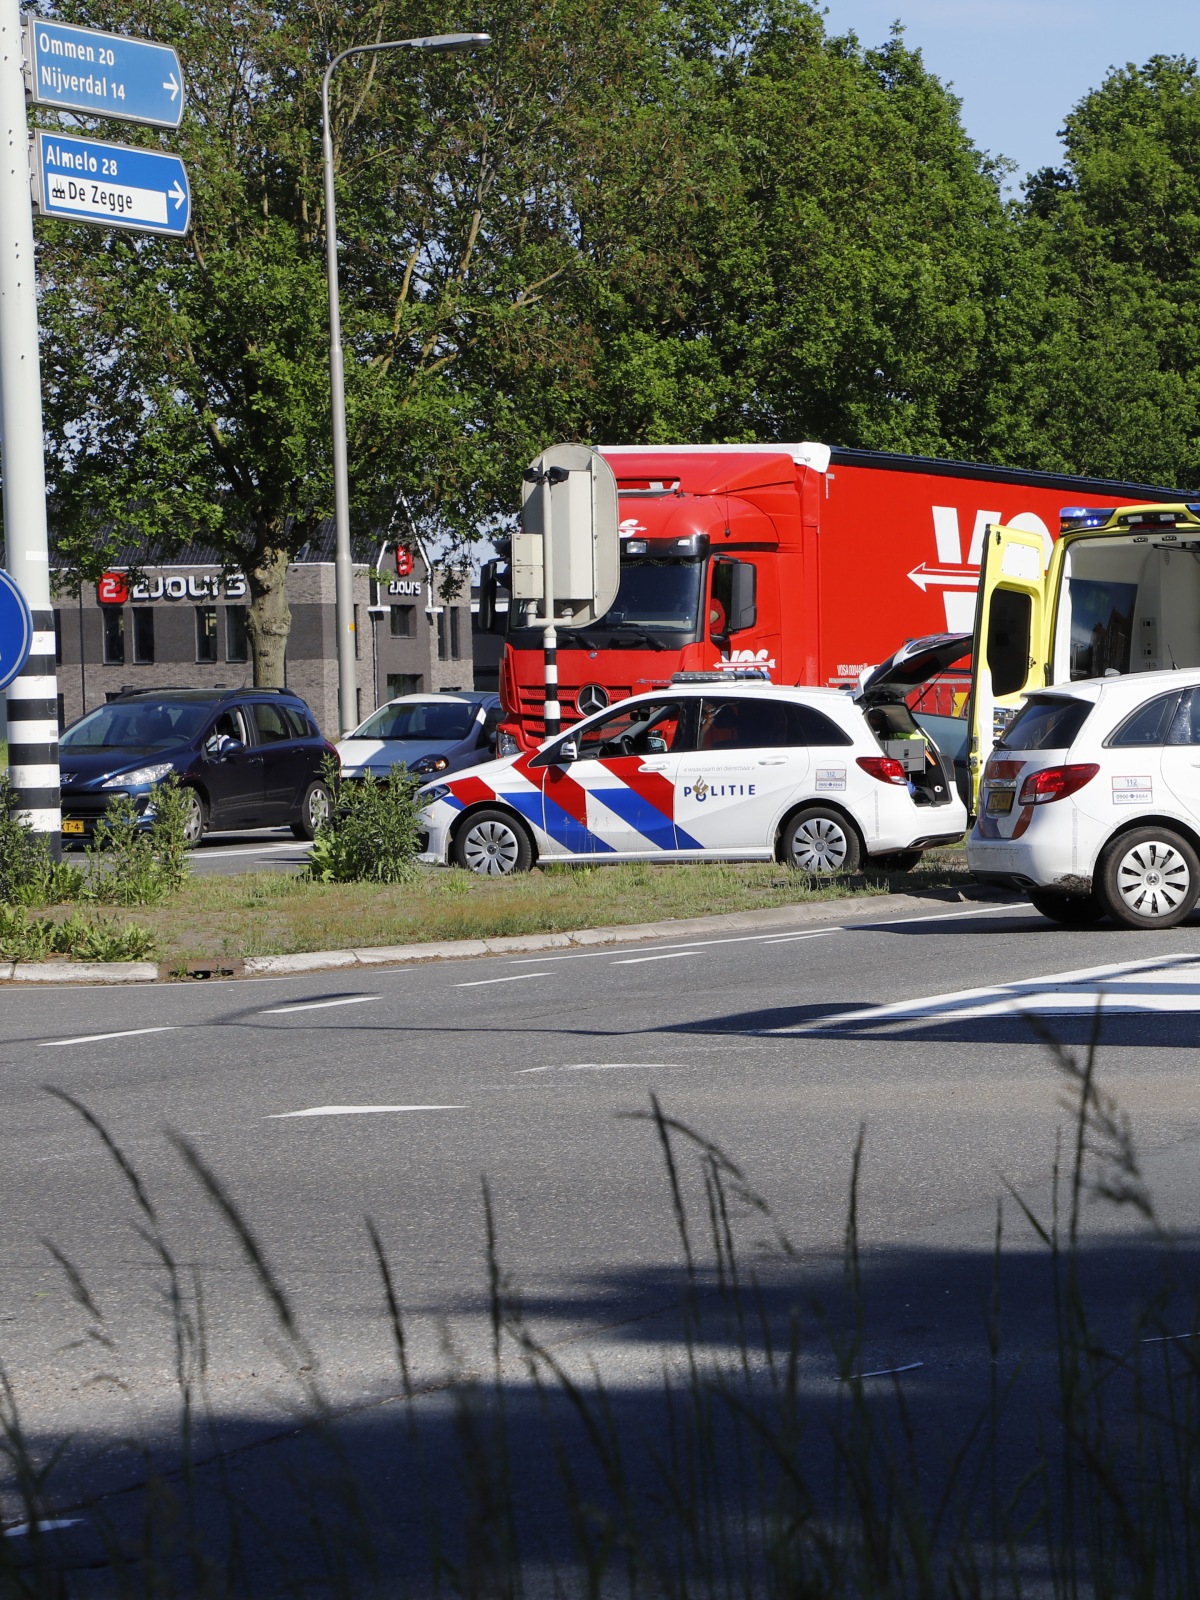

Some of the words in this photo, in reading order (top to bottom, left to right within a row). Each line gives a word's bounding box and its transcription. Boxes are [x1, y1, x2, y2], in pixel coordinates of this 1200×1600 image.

[39, 32, 95, 62] Ommen
[98, 48, 115, 66] 20
[41, 66, 107, 98] Nijverdal
[110, 83, 126, 100] 14
[46, 145, 97, 172] Almelo
[101, 158, 118, 176] 28
[68, 181, 87, 202] De
[91, 186, 133, 213] Zegge
[683, 784, 756, 802] POLITIE
[1126, 778, 1138, 787] 112
